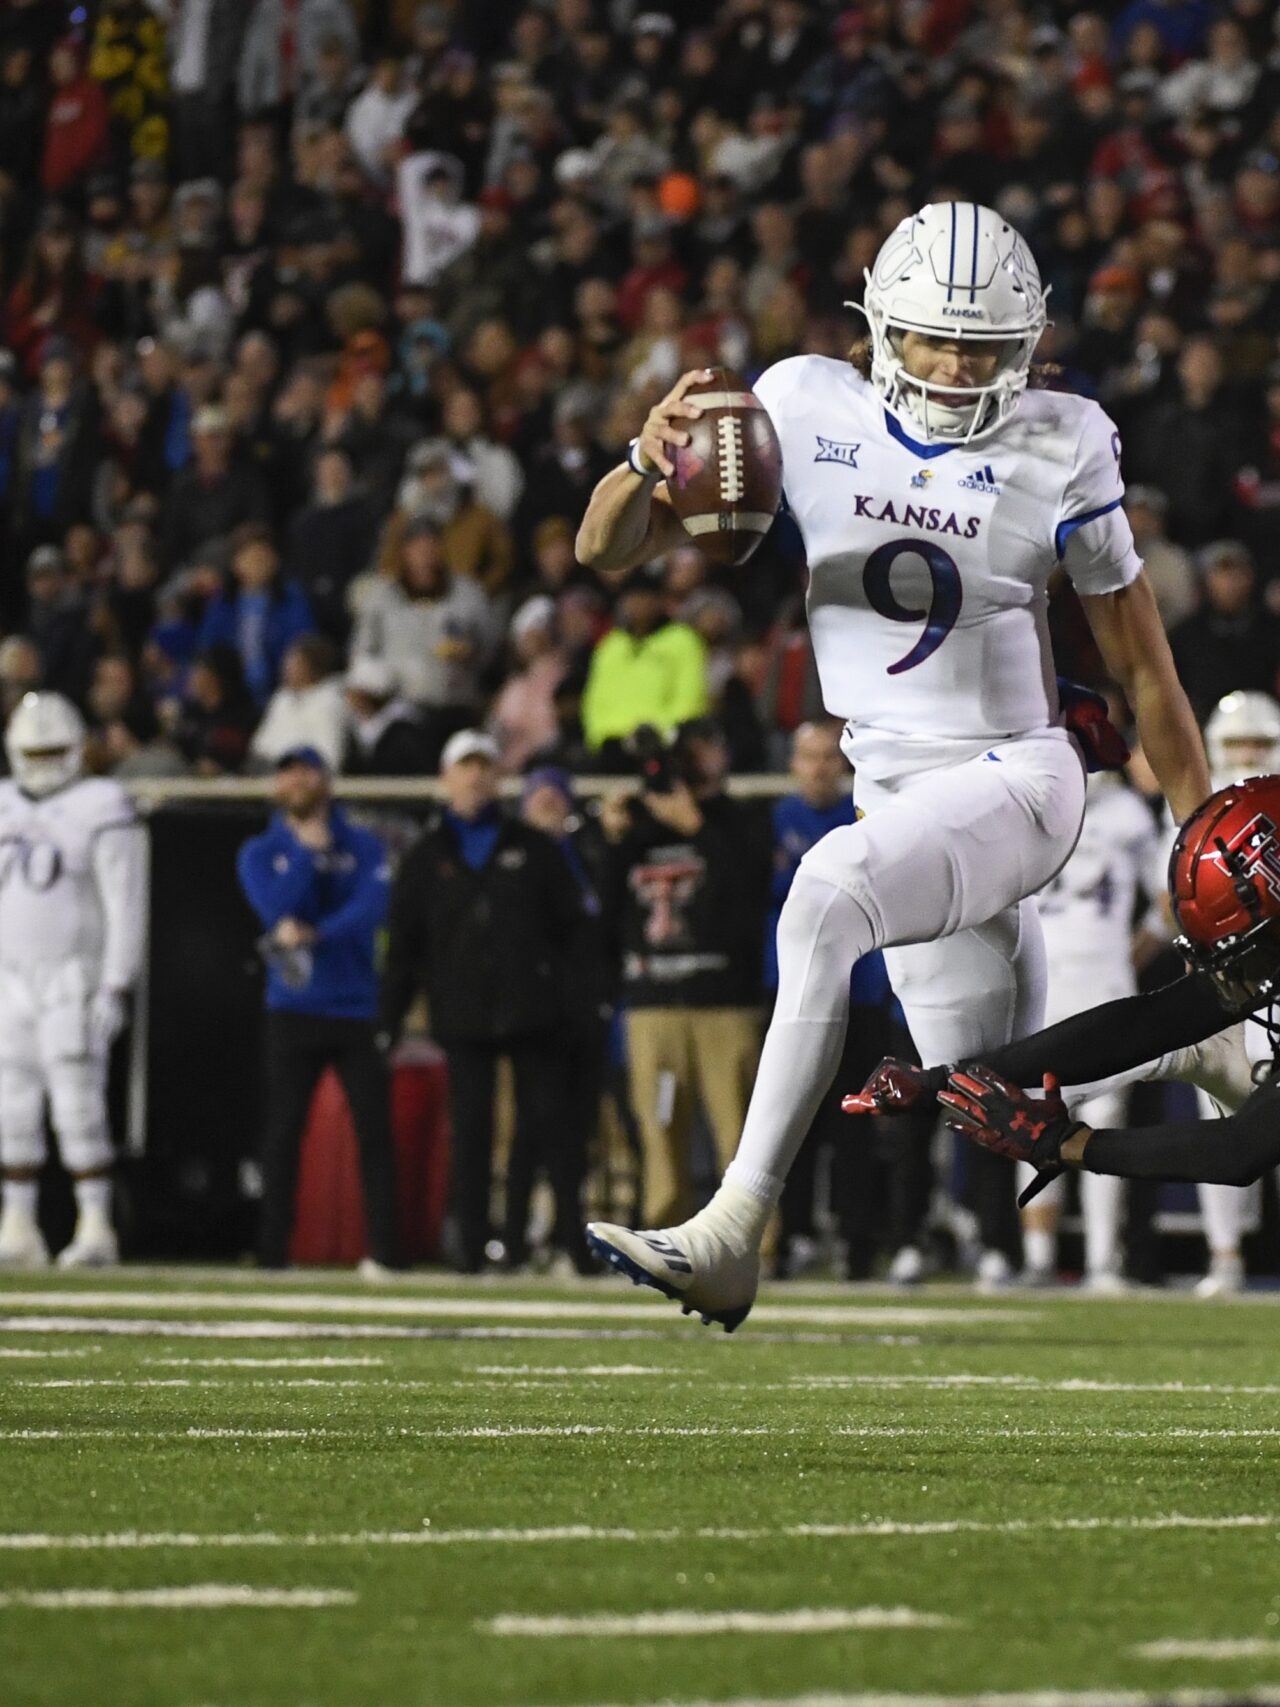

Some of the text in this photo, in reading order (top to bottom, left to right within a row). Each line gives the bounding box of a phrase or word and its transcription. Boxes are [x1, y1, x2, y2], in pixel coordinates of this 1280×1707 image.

[942, 306, 985, 319] KANSAS
[957, 478, 1001, 495] adidas
[854, 494, 981, 539] KANSAS
[863, 538, 963, 675] 9
